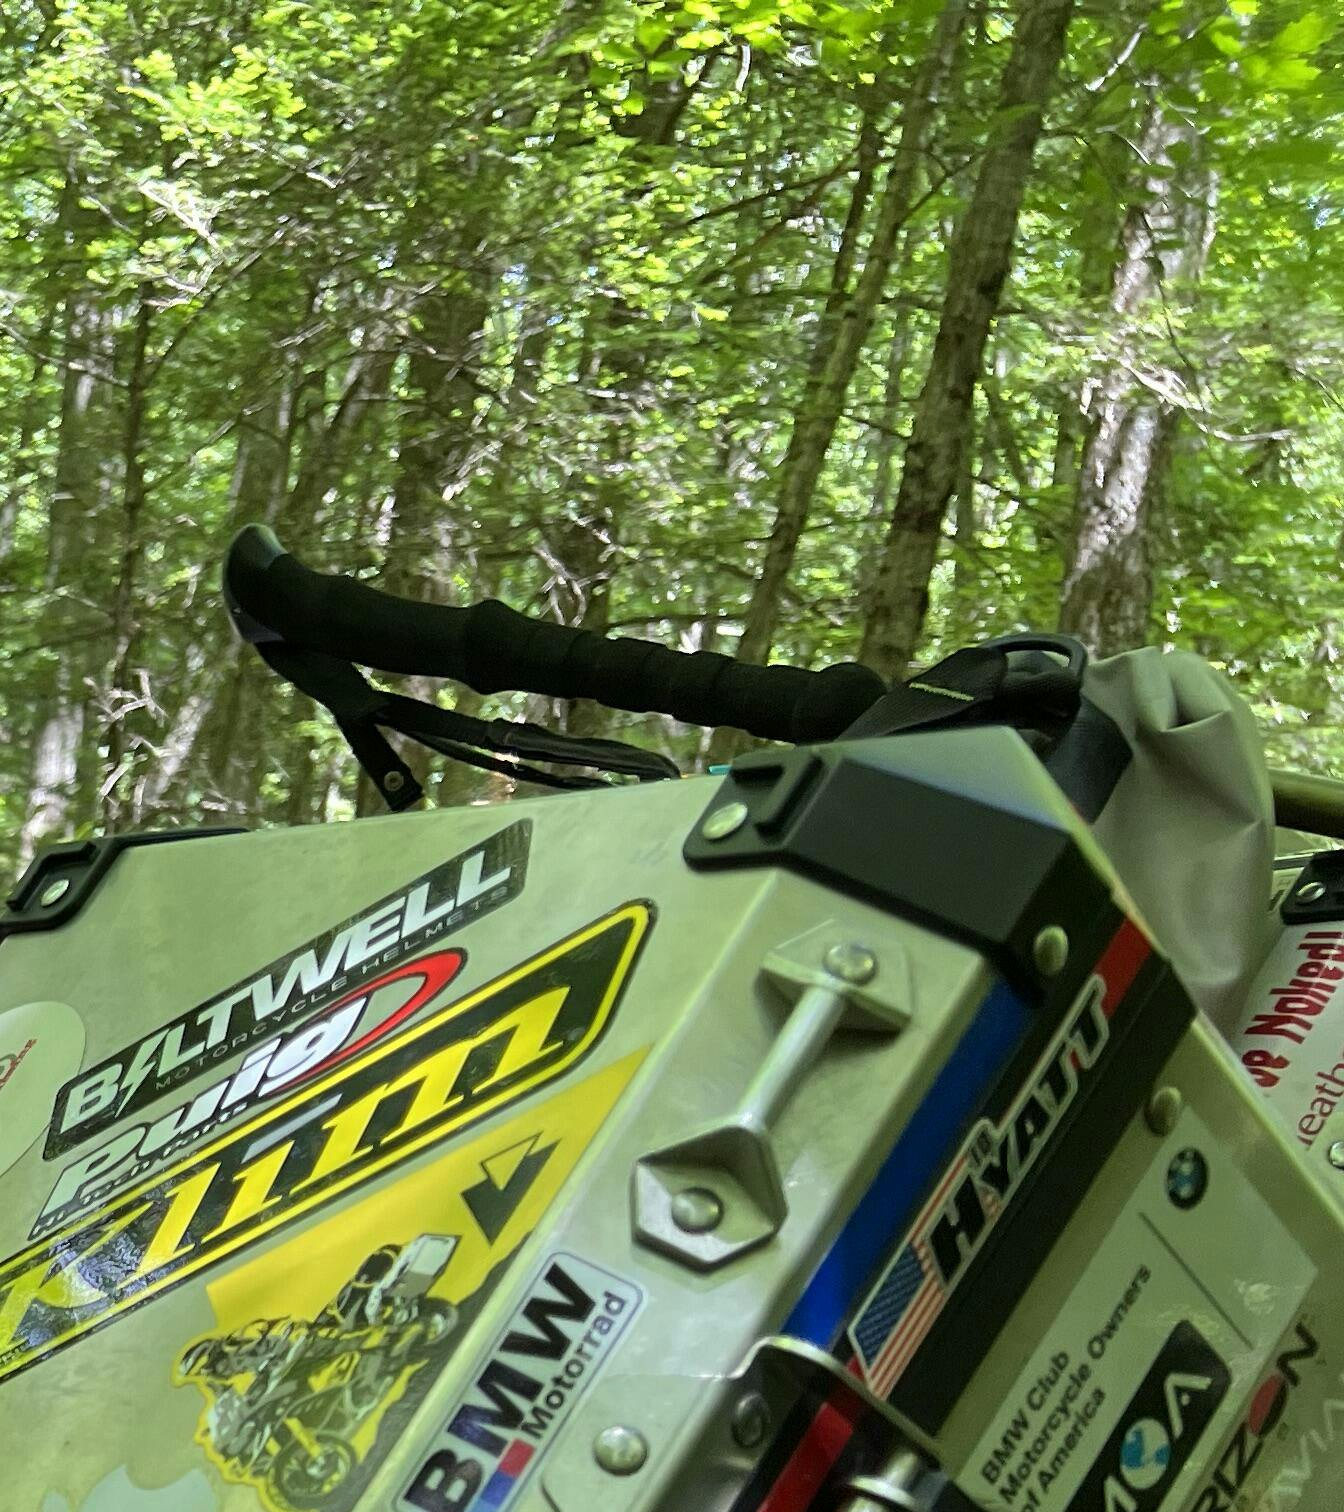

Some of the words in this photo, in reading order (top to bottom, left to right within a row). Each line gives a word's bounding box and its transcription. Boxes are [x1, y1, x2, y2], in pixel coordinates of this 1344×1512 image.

[155, 977, 347, 1089] MOTORCYCLE
[361, 886, 508, 975] HELMETS
[40, 997, 369, 1219] Puig
[927, 980, 1110, 1283] HYATT
[520, 1291, 625, 1440] Motorrad
[979, 1414, 1029, 1486] BMW
[1026, 1350, 1070, 1412] Club
[998, 1361, 1093, 1506] Motorcycle
[1086, 1265, 1152, 1361] Owners
[1037, 1388, 1108, 1492] America
